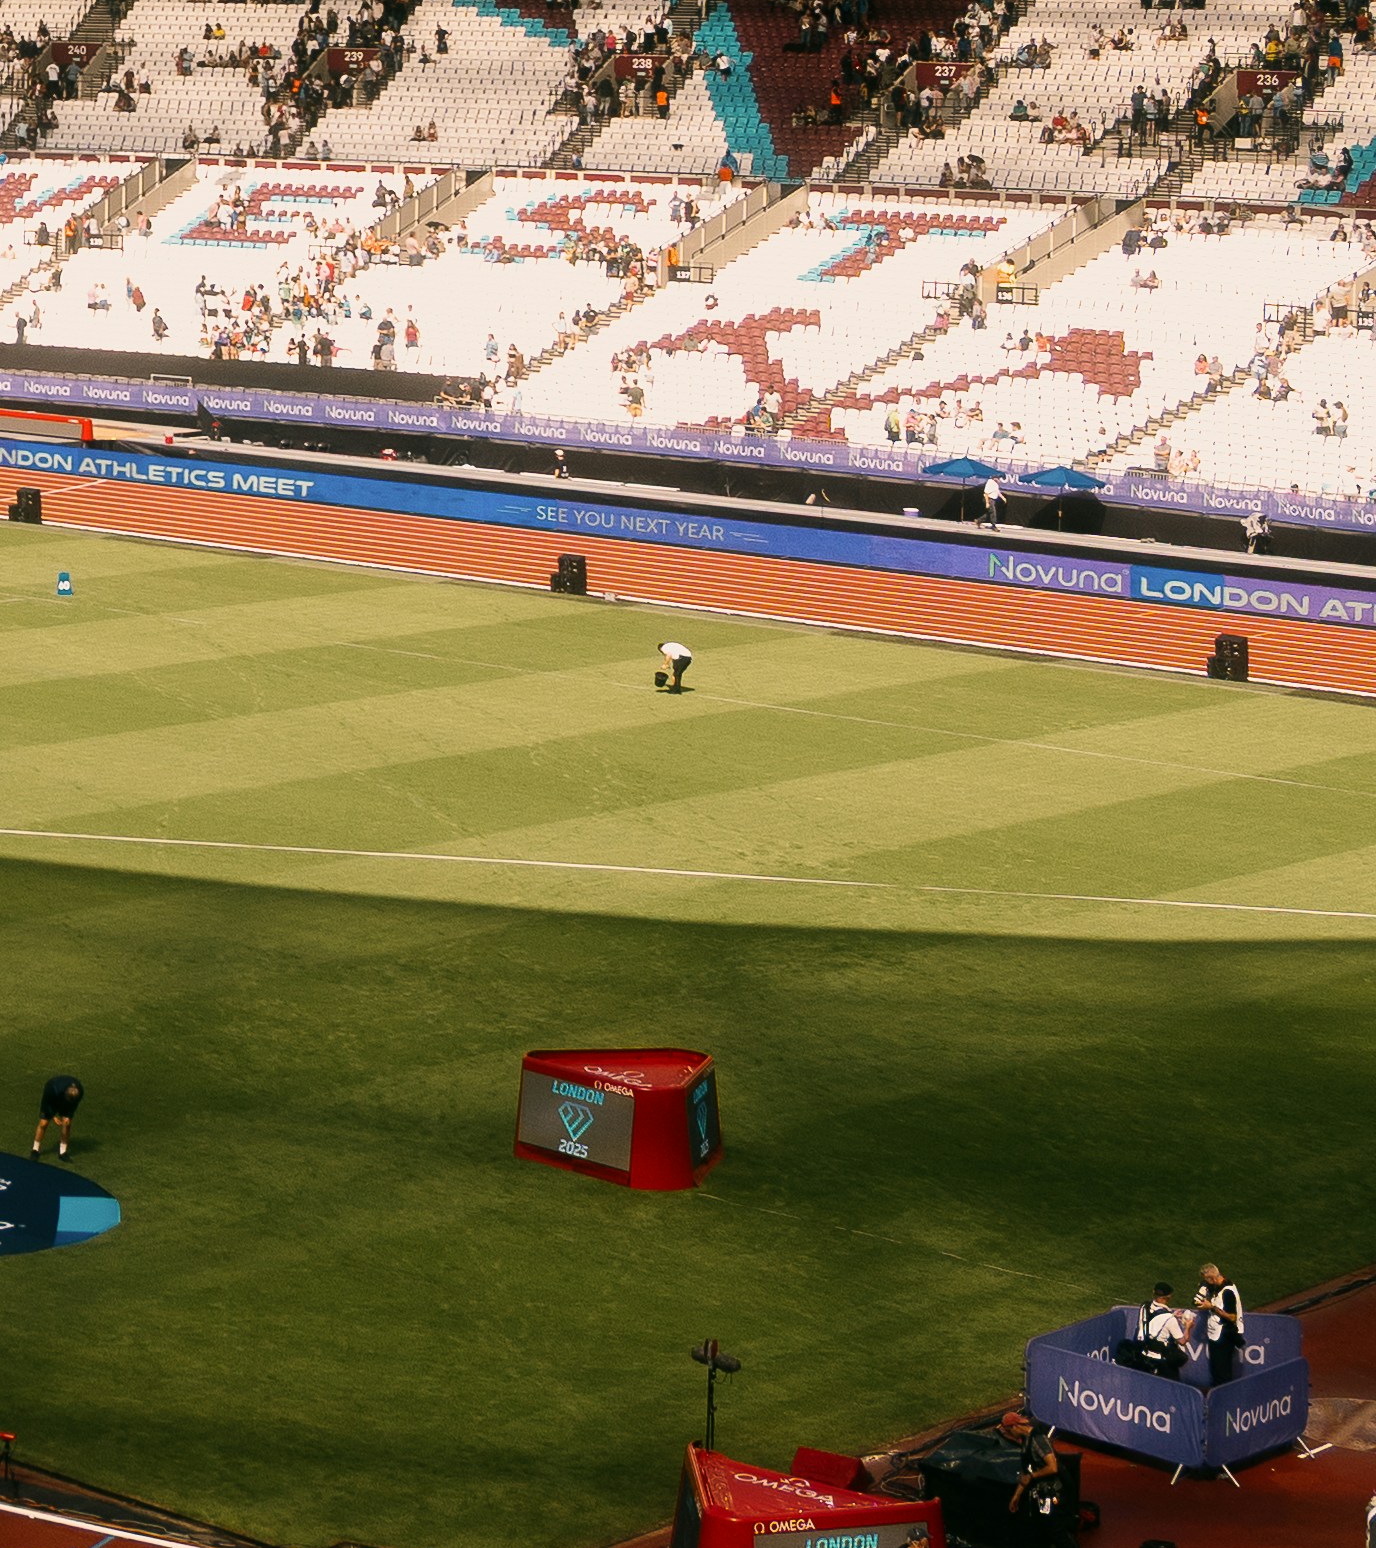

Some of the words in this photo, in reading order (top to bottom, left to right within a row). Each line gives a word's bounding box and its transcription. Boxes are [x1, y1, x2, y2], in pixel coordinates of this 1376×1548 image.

[68, 46, 87, 55] 240
[344, 52, 363, 61] 239
[632, 59, 652, 68] 238
[934, 66, 956, 77] 237
[1256, 75, 1279, 85] 236
[24, 380, 71, 397] Novuna
[83, 384, 130, 402] Novuna
[142, 390, 190, 407] Novuna
[204, 395, 251, 412] Novuna
[263, 400, 313, 417] Novuna
[325, 406, 374, 422] Novuna
[388, 411, 438, 428] Novuna
[452, 416, 501, 433] Novuna
[515, 420, 566, 439] Novuna
[580, 426, 632, 446] Novuna
[647, 434, 700, 452] Novuna
[714, 441, 765, 459] Novuna
[780, 447, 833, 466] Novuna
[849, 453, 903, 472] Novuna
[78, 458, 226, 489] ATHLETICS
[233, 473, 315, 497] MEET
[1131, 484, 1187, 504] Novuna
[1203, 493, 1262, 512] Novuna
[1278, 501, 1335, 522] Novuna
[536, 505, 568, 524] SEE
[573, 510, 615, 529] YOU
[621, 515, 671, 535] NEXT
[675, 521, 724, 542] YEAR
[989, 552, 1123, 593] Novuna
[1140, 577, 1310, 616] LONDON
[551, 1080, 605, 1106] LONDON
[604, 1082, 634, 1098] OMEGA
[558, 1139, 589, 1159] 2025
[1058, 1375, 1171, 1433] Novuna
[1226, 1394, 1291, 1437] Novuna
[734, 1473, 835, 1508] OMEGA
[769, 1517, 816, 1533] OMEGA
